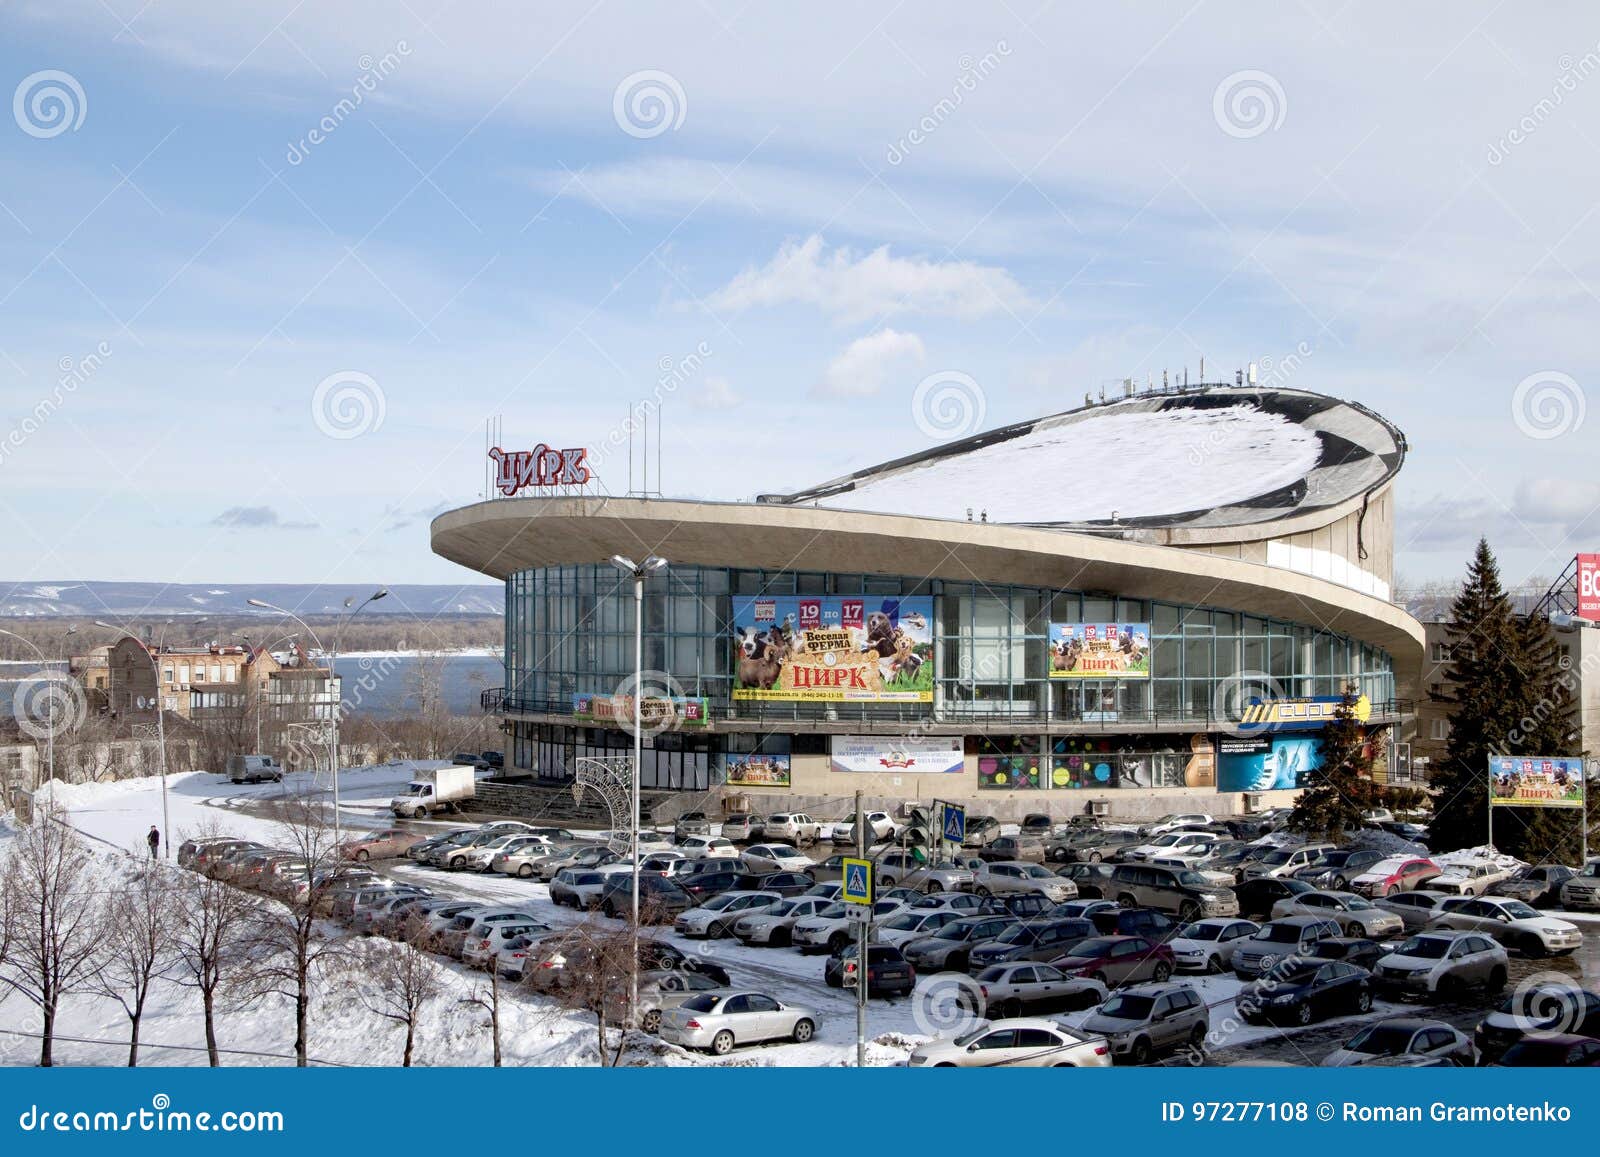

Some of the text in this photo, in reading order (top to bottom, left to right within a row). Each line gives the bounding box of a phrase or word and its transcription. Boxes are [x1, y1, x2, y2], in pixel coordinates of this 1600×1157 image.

[488, 443, 590, 496] ЦИРК
[800, 605, 819, 619] 19
[824, 611, 839, 619] по
[843, 605, 862, 619] 17
[807, 640, 851, 651] ФЕРМА
[793, 665, 867, 688] ЦИРК
[687, 706, 696, 714] 17
